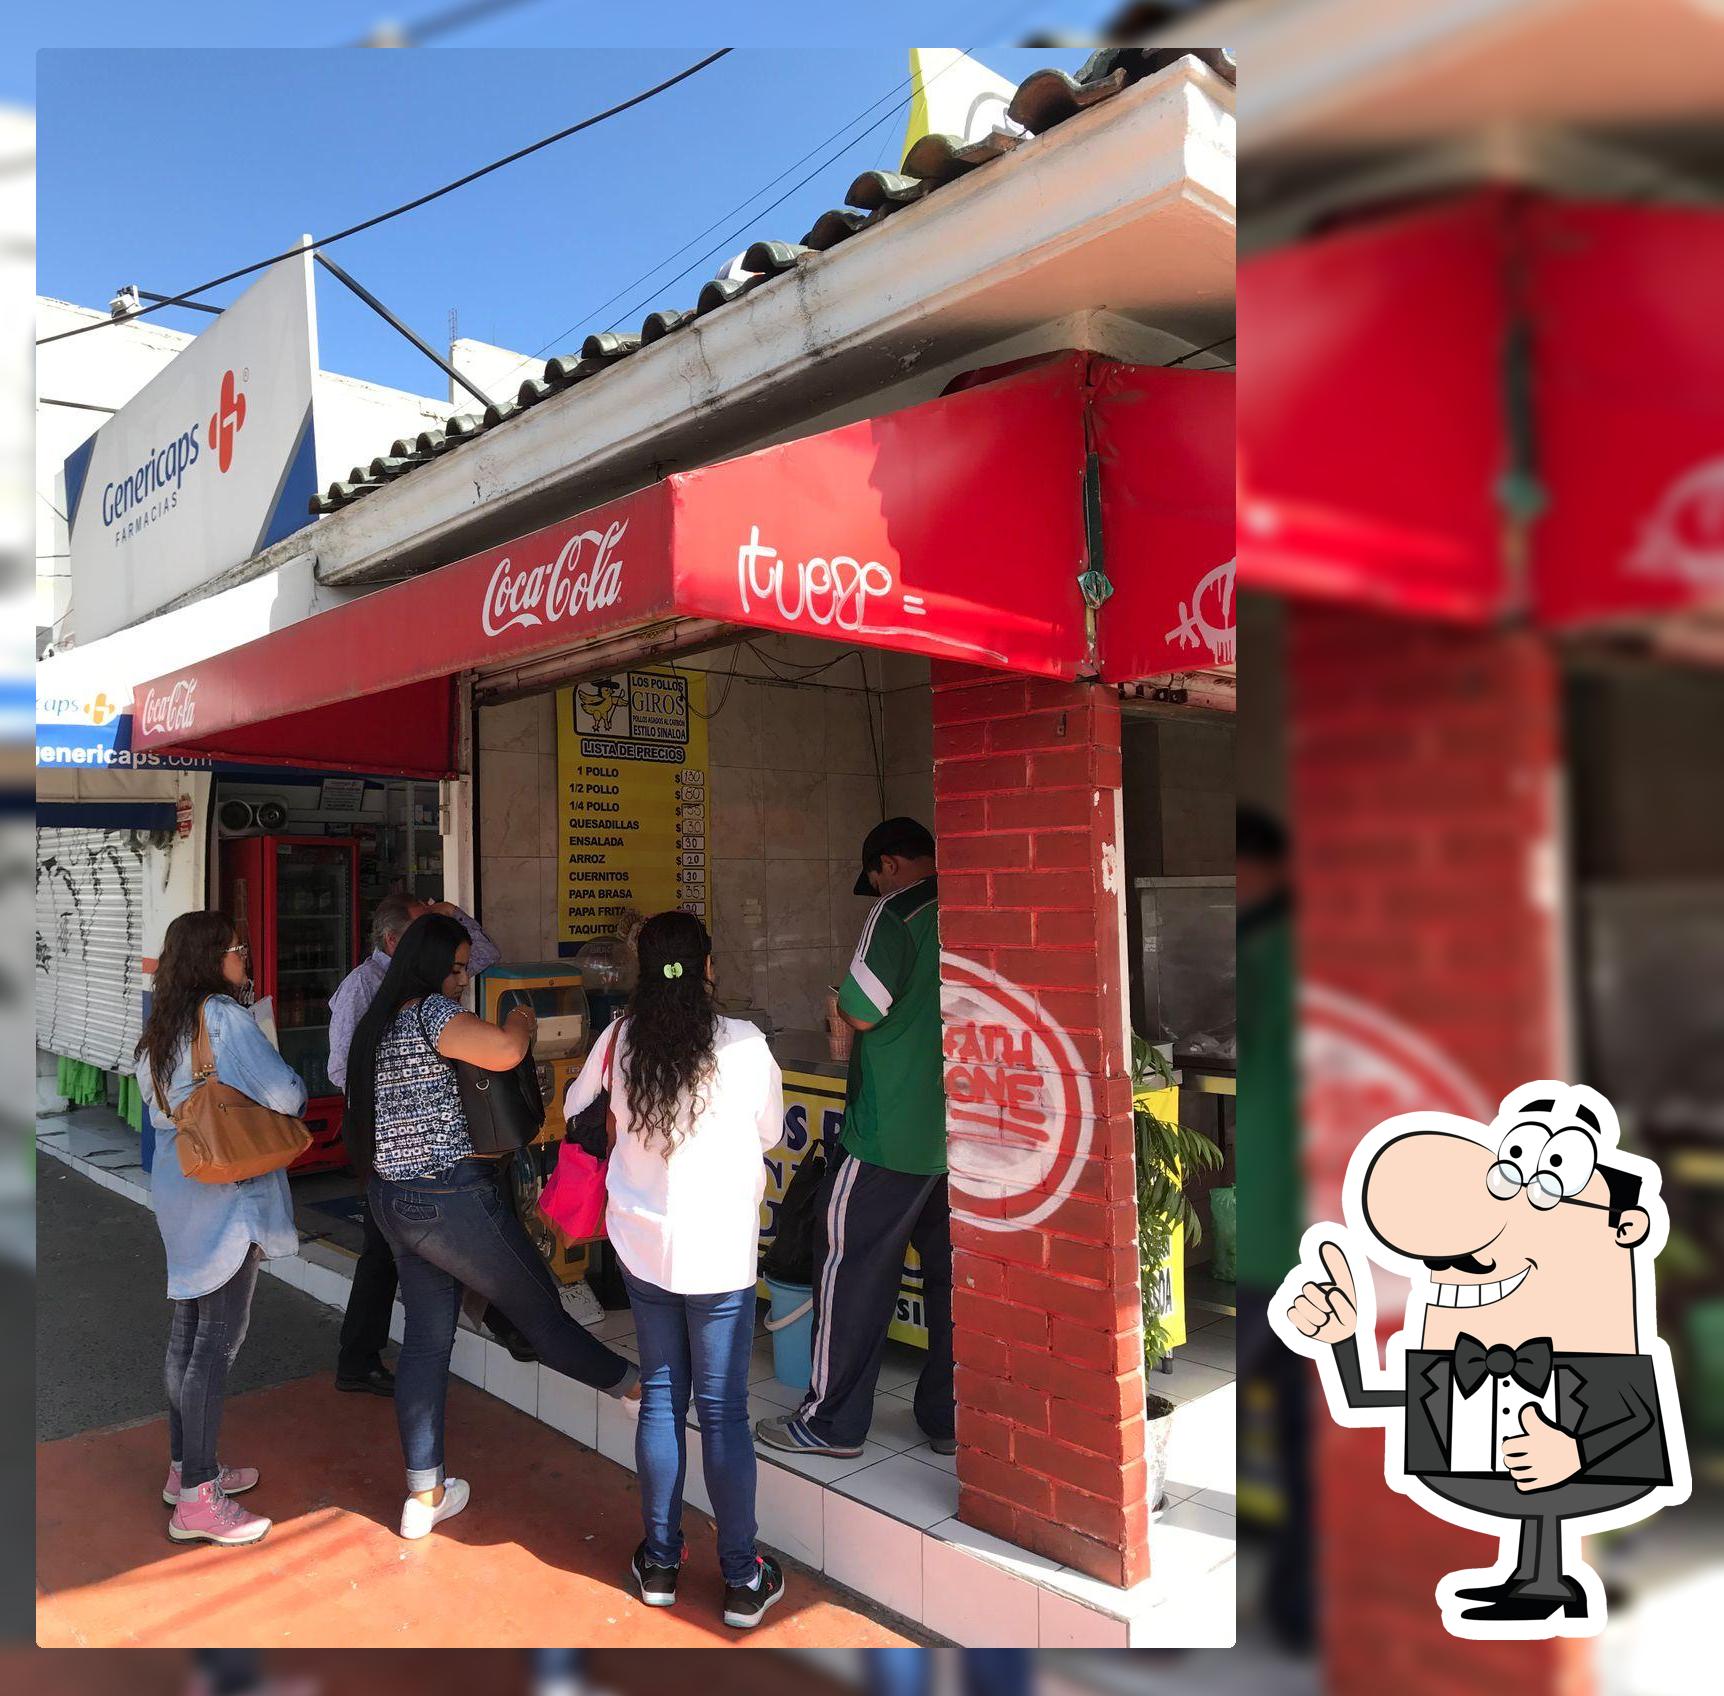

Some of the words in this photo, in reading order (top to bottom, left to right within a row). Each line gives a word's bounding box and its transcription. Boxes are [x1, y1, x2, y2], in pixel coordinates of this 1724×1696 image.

[102, 423, 200, 527] Genericaps
[115, 491, 178, 547] FARMACIAS
[482, 517, 630, 637] Coca-Cola
[632, 676, 649, 688] LOS
[651, 678, 684, 692] POLLOS
[632, 690, 685, 716] GIROS
[633, 725, 656, 737] ESTILO
[657, 727, 686, 739] SINALOA
[584, 741, 617, 755] LISTA
[619, 744, 634, 757] DE
[636, 746, 683, 761] PRECIOS
[577, 766, 583, 776] 1
[585, 766, 619, 777] POLLO
[569, 783, 584, 793] 1/2
[586, 784, 620, 795] POLLO
[569, 800, 584, 811] 1/4
[586, 801, 620, 812] POLLO
[569, 818, 640, 830] QUESADILLAS
[569, 836, 624, 847] ENSALADA
[569, 854, 606, 864] ARROZ
[569, 871, 630, 882] CUERNITOS
[569, 889, 595, 899] PAPA
[598, 888, 633, 899] BRASA
[569, 907, 595, 917] PAPA
[944, 1066, 1045, 1109] ONE
